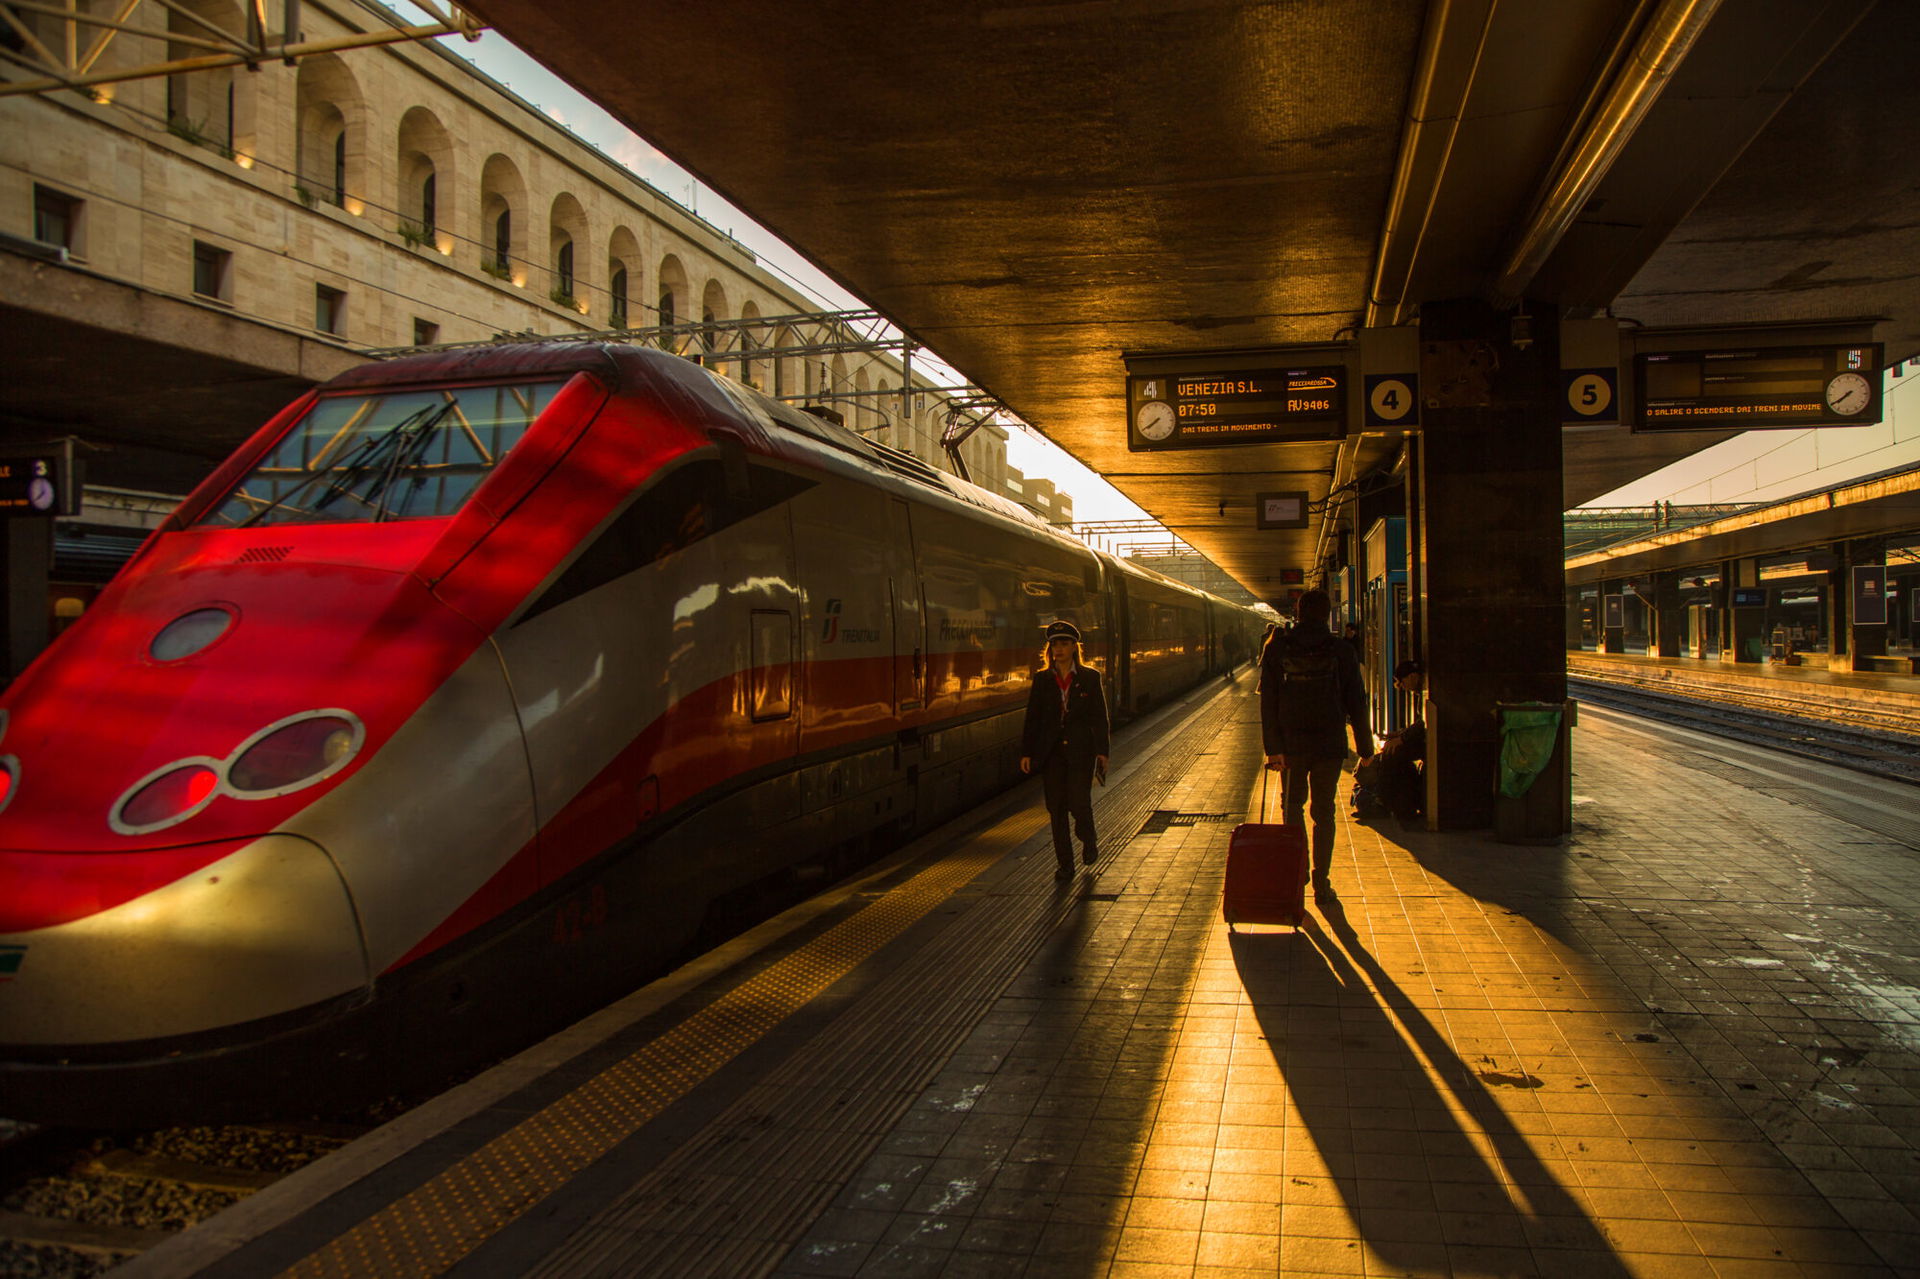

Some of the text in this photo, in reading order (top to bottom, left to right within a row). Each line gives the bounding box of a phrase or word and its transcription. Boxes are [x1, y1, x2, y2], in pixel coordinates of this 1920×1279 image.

[1848, 349, 1861, 369] 5
[1143, 380, 1158, 399] 4
[1177, 380, 1263, 397] VENEZIA S.L.
[1581, 384, 1598, 405] 5
[1382, 389, 1400, 410] 4
[1655, 409, 1684, 417] SALIRE
[1695, 407, 1735, 415] SCENDERE
[1197, 426, 1219, 434] TRENI
[1230, 423, 1272, 431] MOVIMENTO
